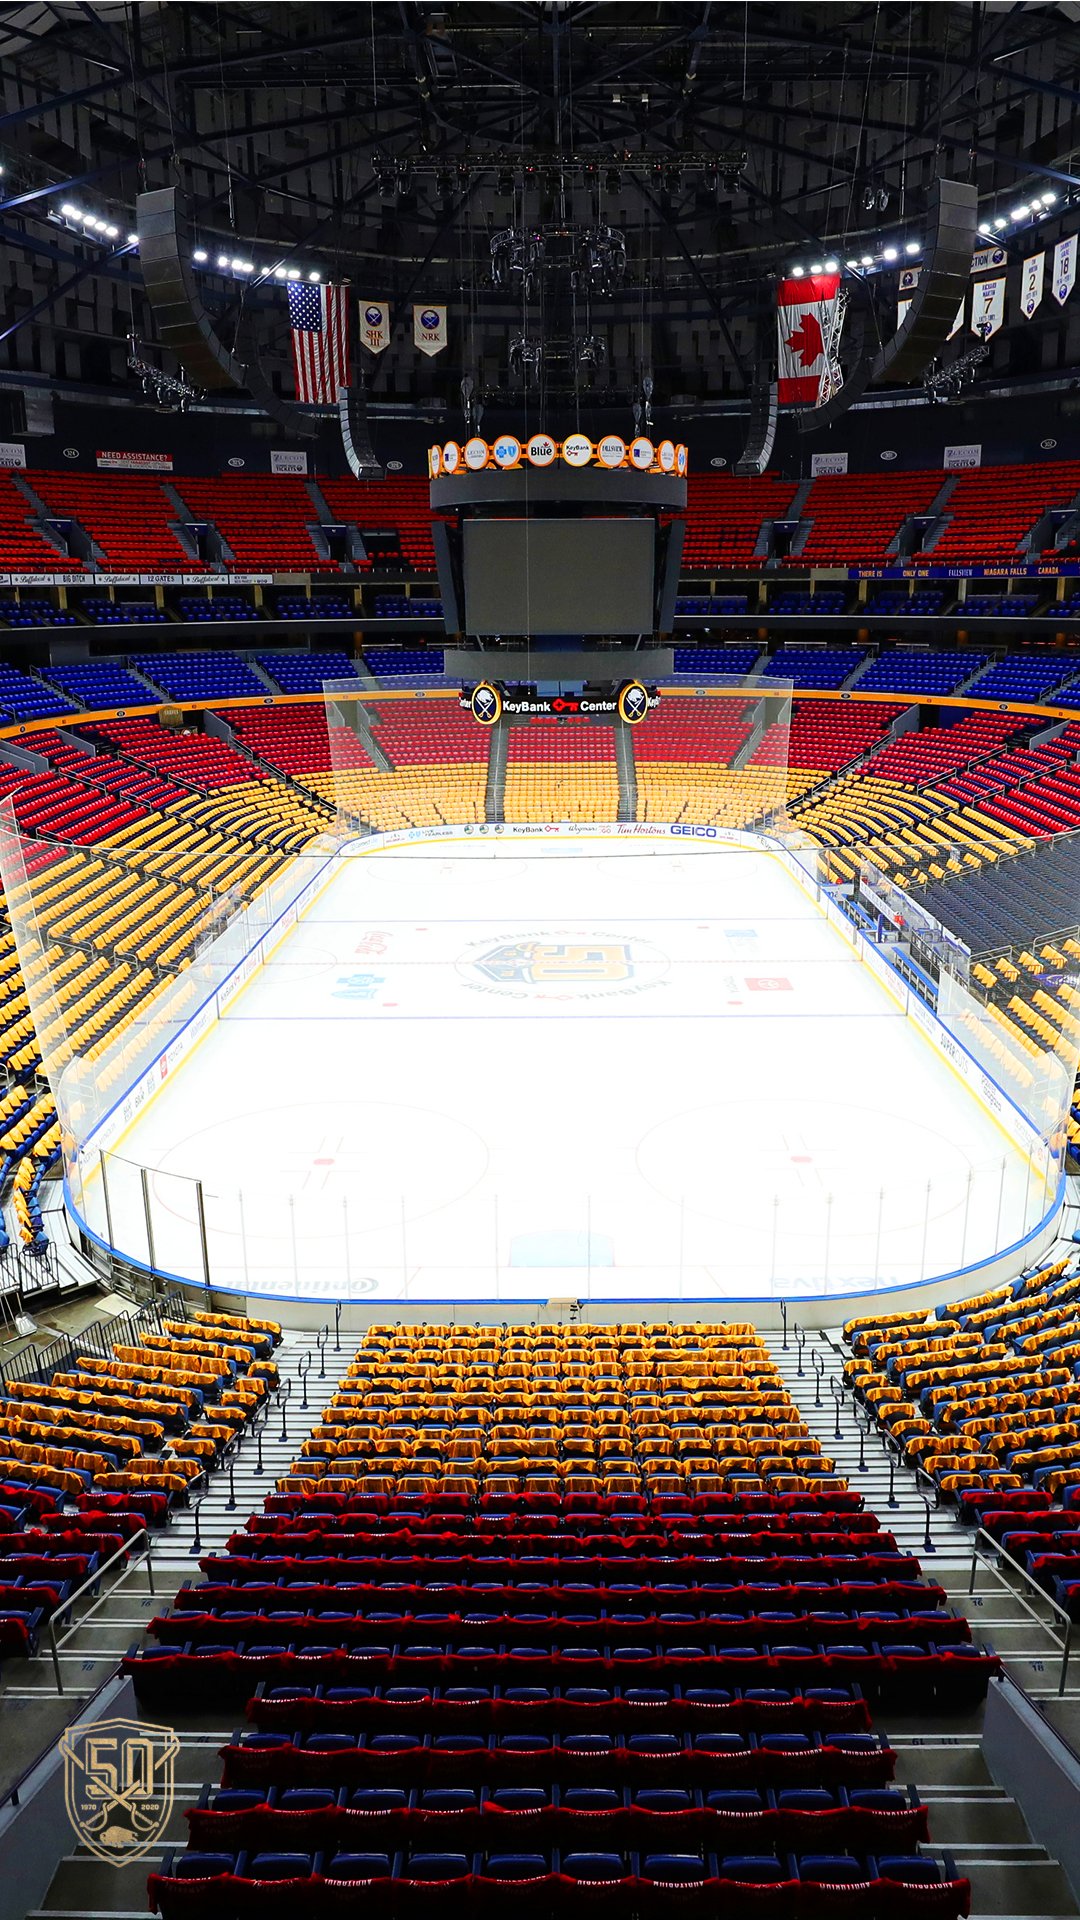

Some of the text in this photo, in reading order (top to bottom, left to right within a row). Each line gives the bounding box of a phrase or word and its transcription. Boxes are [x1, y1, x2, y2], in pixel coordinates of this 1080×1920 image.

[1060, 257, 1070, 277] 18
[1028, 274, 1037, 291] 2
[983, 297, 993, 314] 7
[365, 329, 384, 339] SHK
[421, 332, 440, 341] NRK
[370, 338, 380, 347] III
[530, 446, 553, 456] Blue
[566, 444, 590, 453] KeyBank
[101, 451, 168, 462] NEED ASSISTANCE?
[917, 569, 929, 577] ONE
[983, 568, 1009, 576] NIAGARA
[1009, 567, 1027, 575] FALLS
[1038, 566, 1059, 574] CANADA
[502, 700, 617, 714] KeyBank Center
[512, 825, 544, 834] KeyBank
[617, 824, 666, 835] Tim Hortons
[670, 825, 717, 838] GEICO
